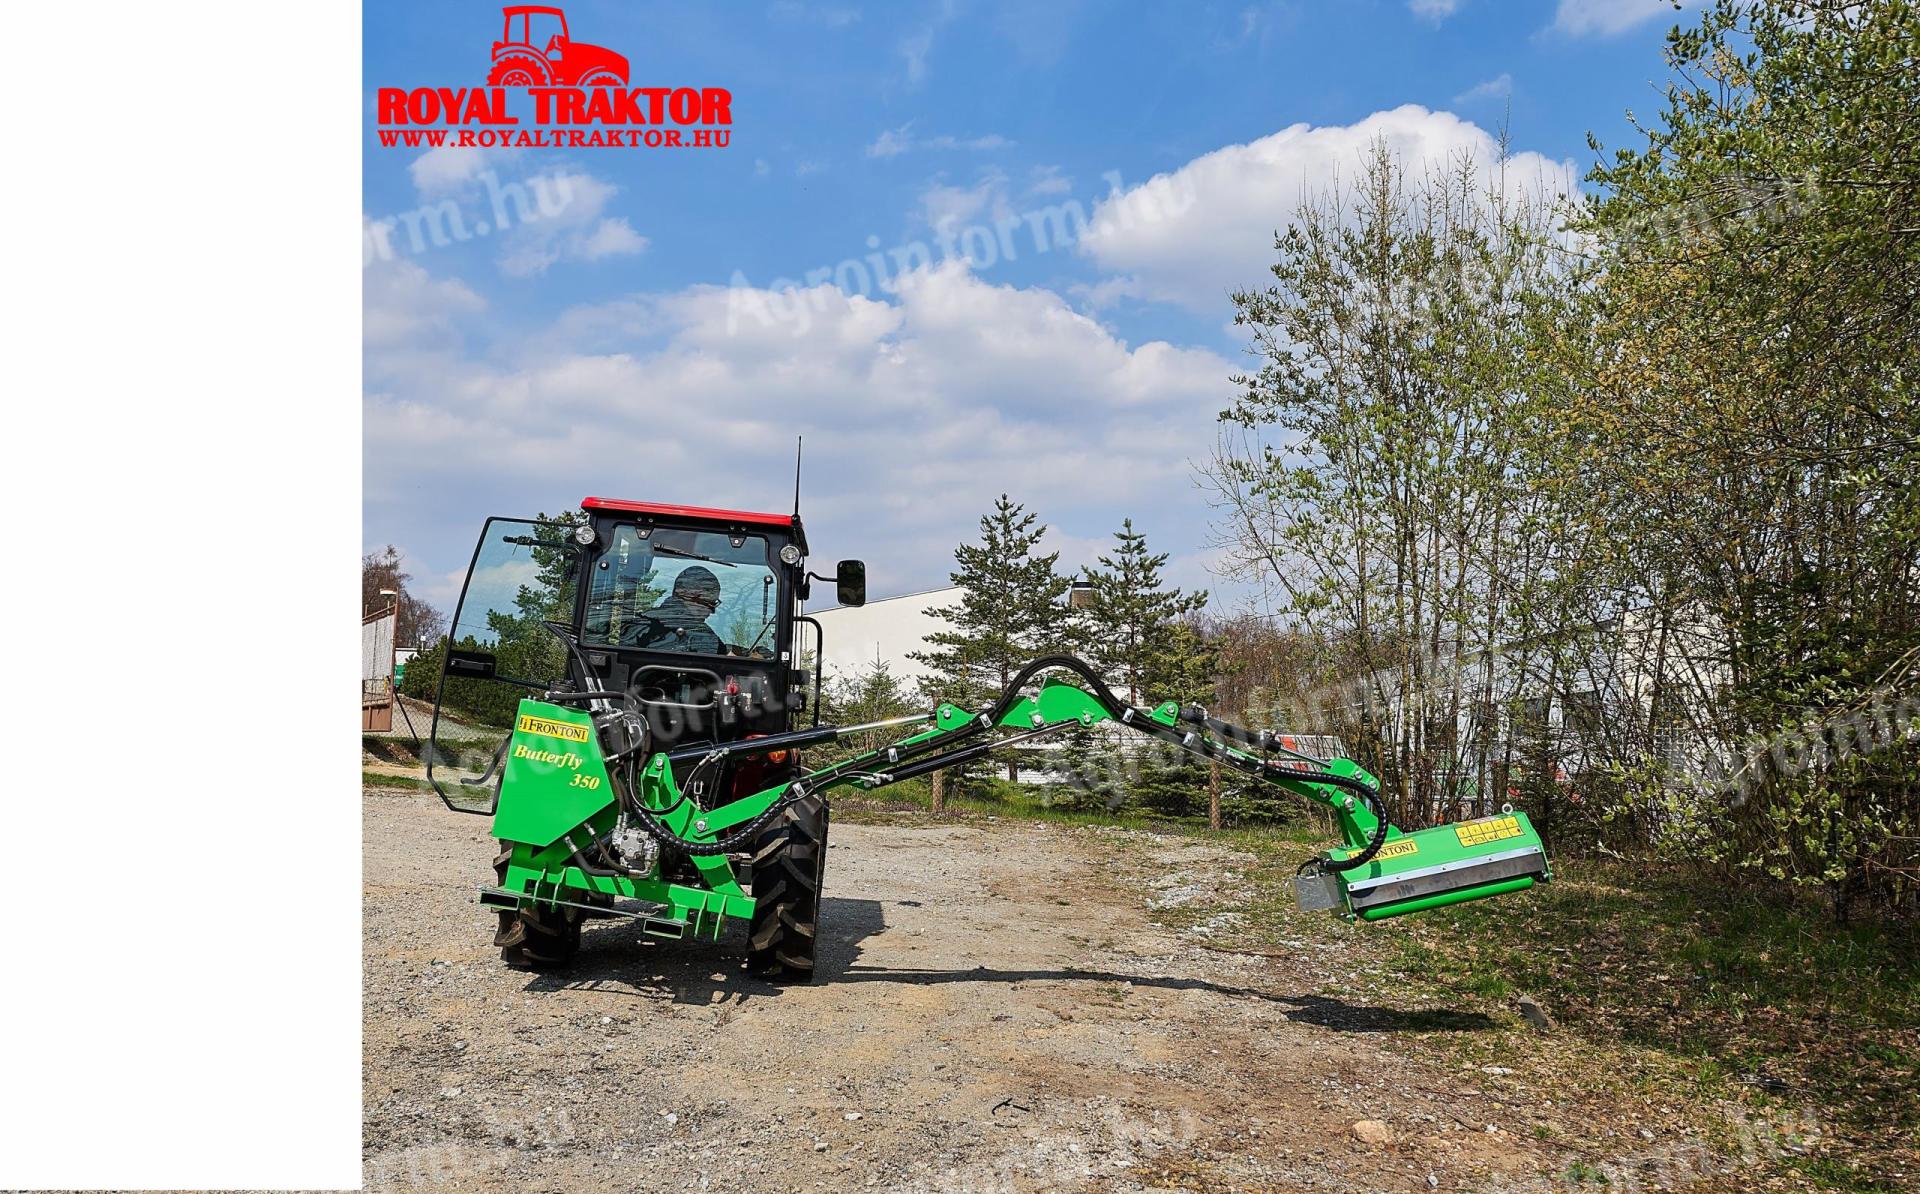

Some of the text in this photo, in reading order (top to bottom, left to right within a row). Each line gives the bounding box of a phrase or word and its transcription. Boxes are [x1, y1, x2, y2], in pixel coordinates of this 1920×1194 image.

[529, 719, 586, 740] FRONTONI
[514, 744, 583, 770] Butterfly
[569, 773, 600, 790] 350
[1358, 843, 1416, 859] ONTONI
